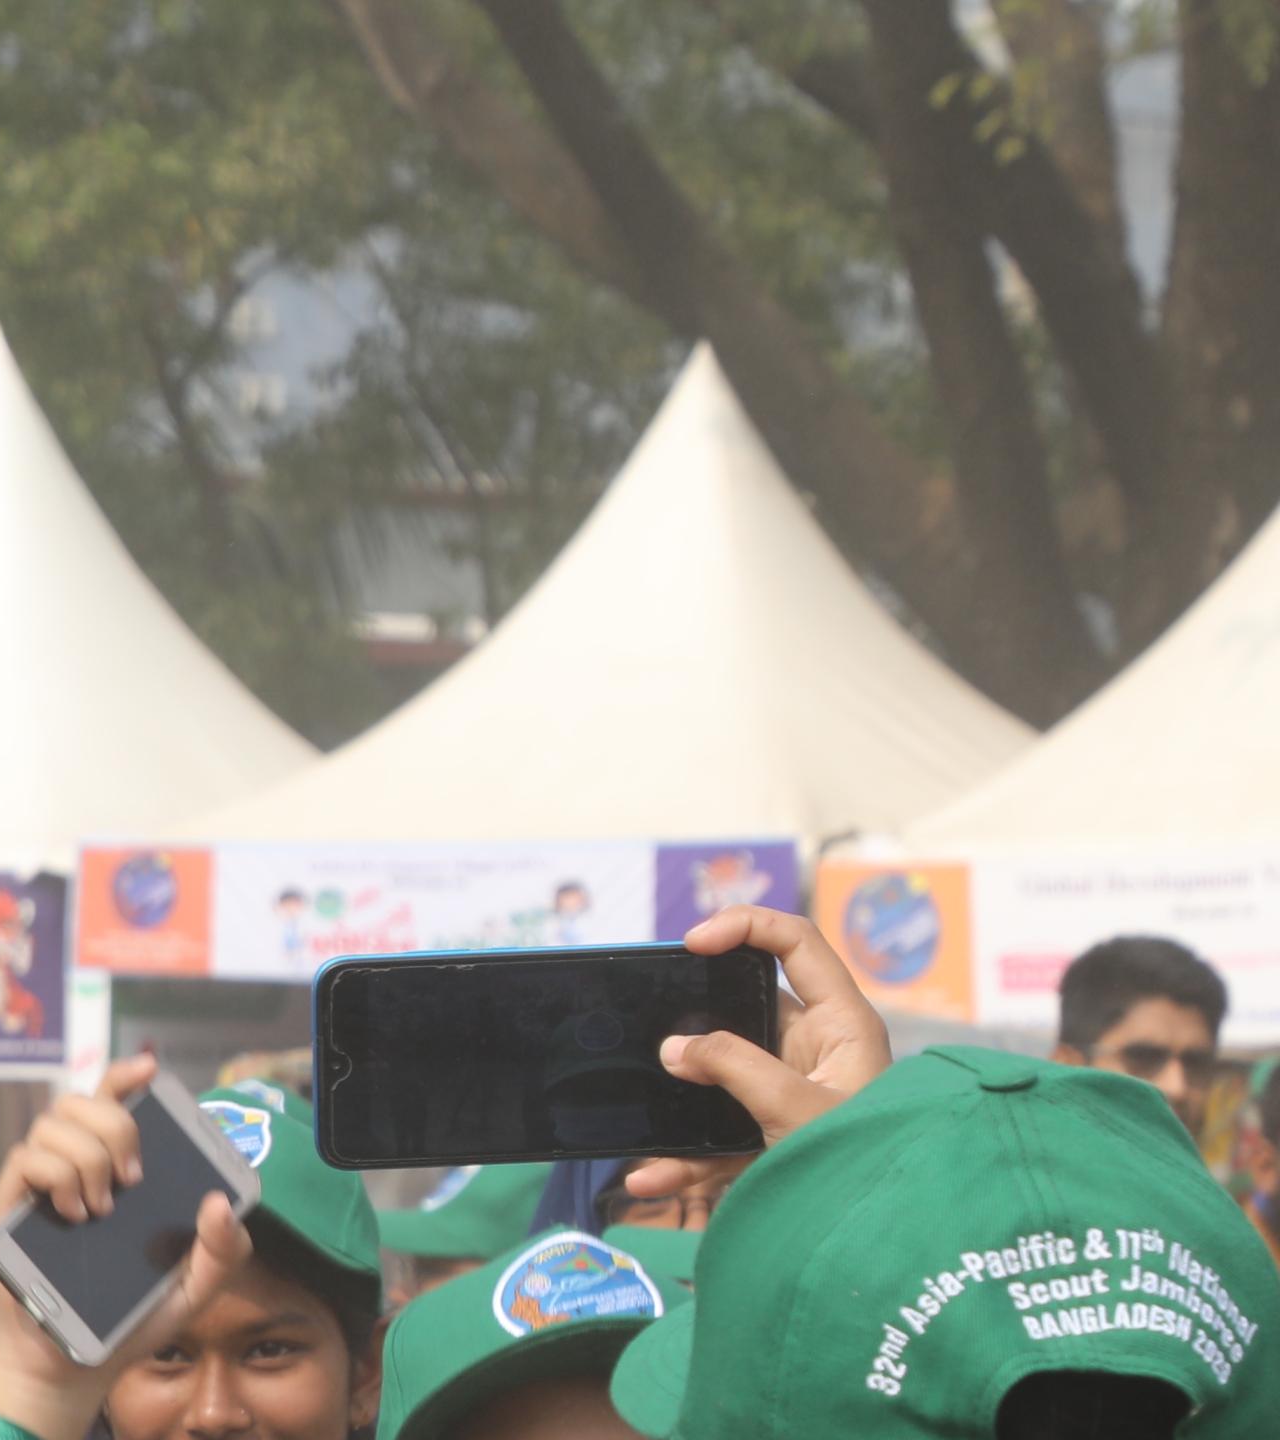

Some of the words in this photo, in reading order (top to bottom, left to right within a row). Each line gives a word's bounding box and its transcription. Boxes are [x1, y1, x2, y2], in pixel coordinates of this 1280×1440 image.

[866, 1324, 910, 1397] 32nd
[899, 1232, 1077, 1336] Asia-Pacific
[1082, 1228, 1112, 1261] &
[1168, 1241, 1259, 1346] National
[1007, 1267, 1110, 1310] Scout
[1119, 1264, 1245, 1364] Jamboree
[1022, 1302, 1193, 1340] BANGLADESH
